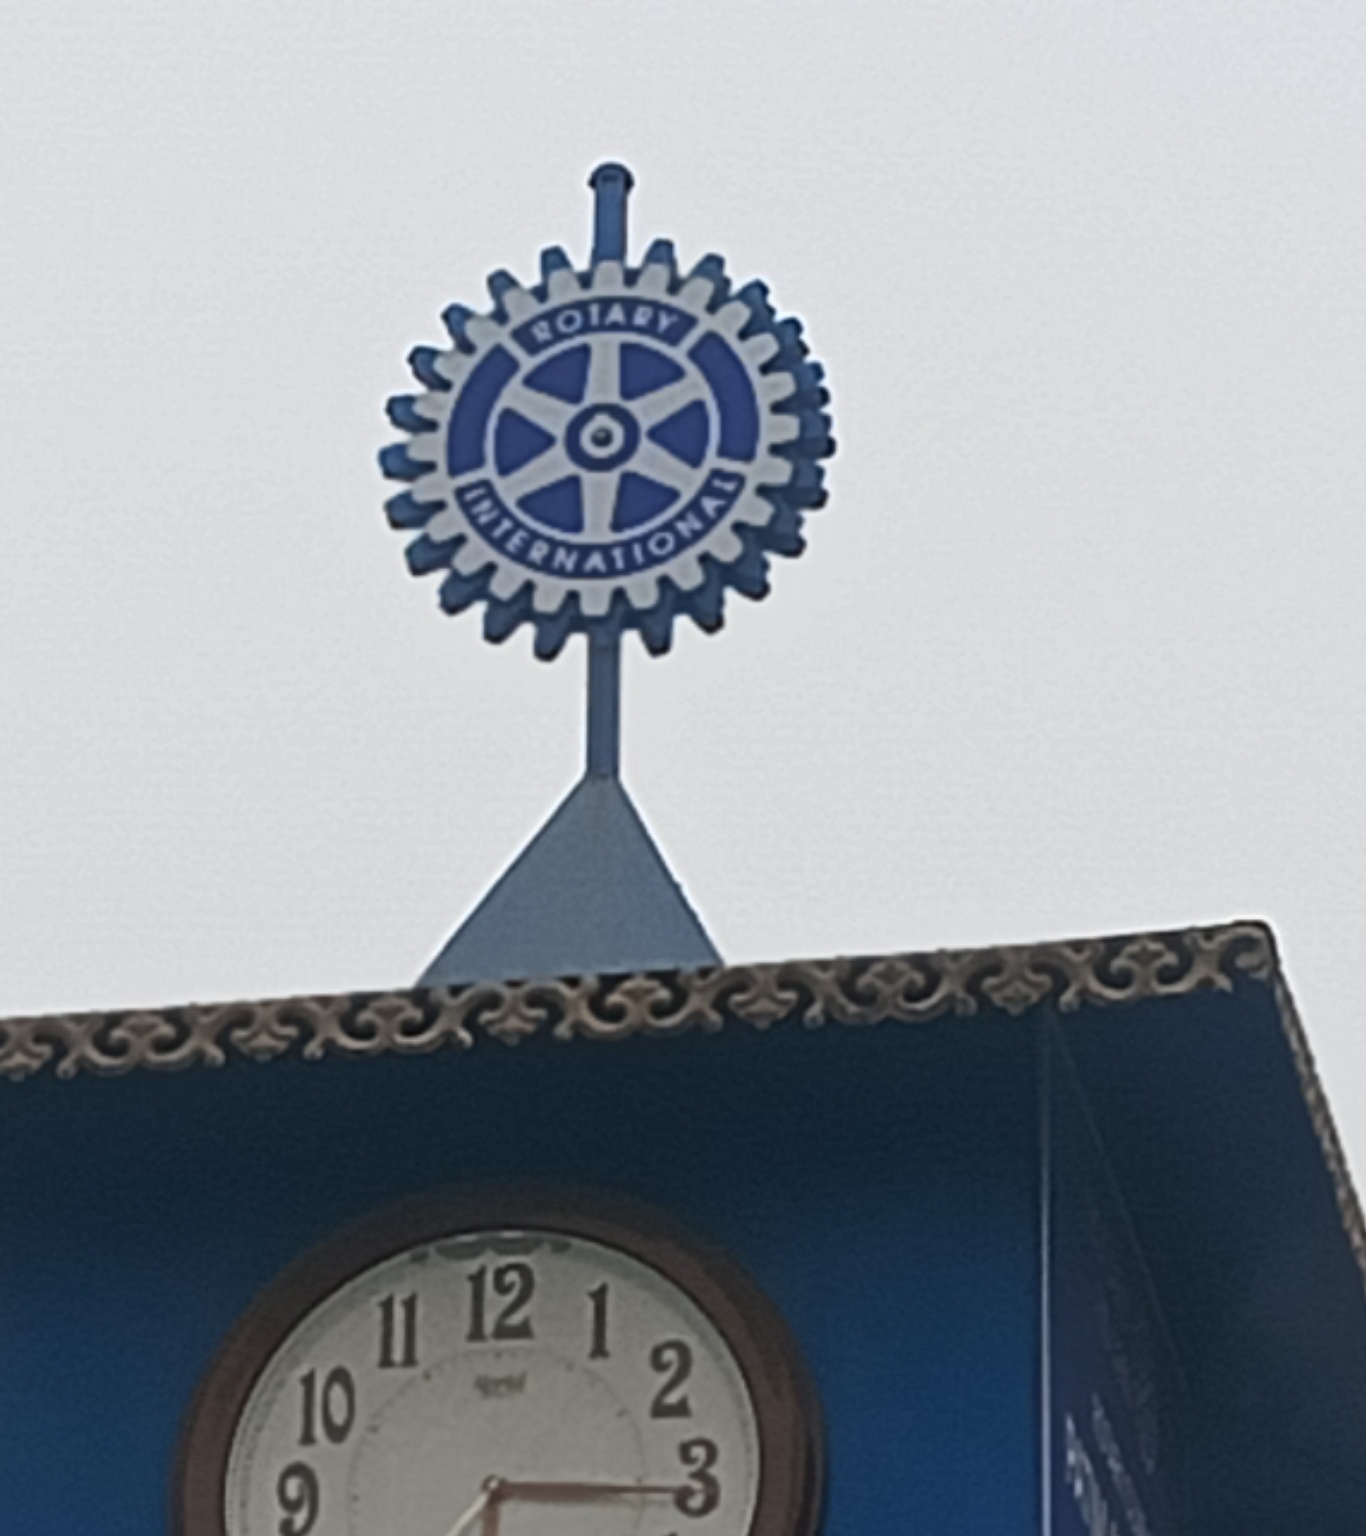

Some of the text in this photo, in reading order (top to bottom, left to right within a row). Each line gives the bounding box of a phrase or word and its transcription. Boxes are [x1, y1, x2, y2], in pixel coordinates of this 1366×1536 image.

[532, 305, 679, 343] ROTARY
[463, 475, 741, 574] INTERNATIONAL
[377, 1293, 419, 1369] 11
[466, 1263, 534, 1342] 12
[588, 1283, 611, 1360] 1
[299, 1366, 355, 1447] 10
[650, 1340, 693, 1419] 2
[675, 1437, 720, 1518] 3
